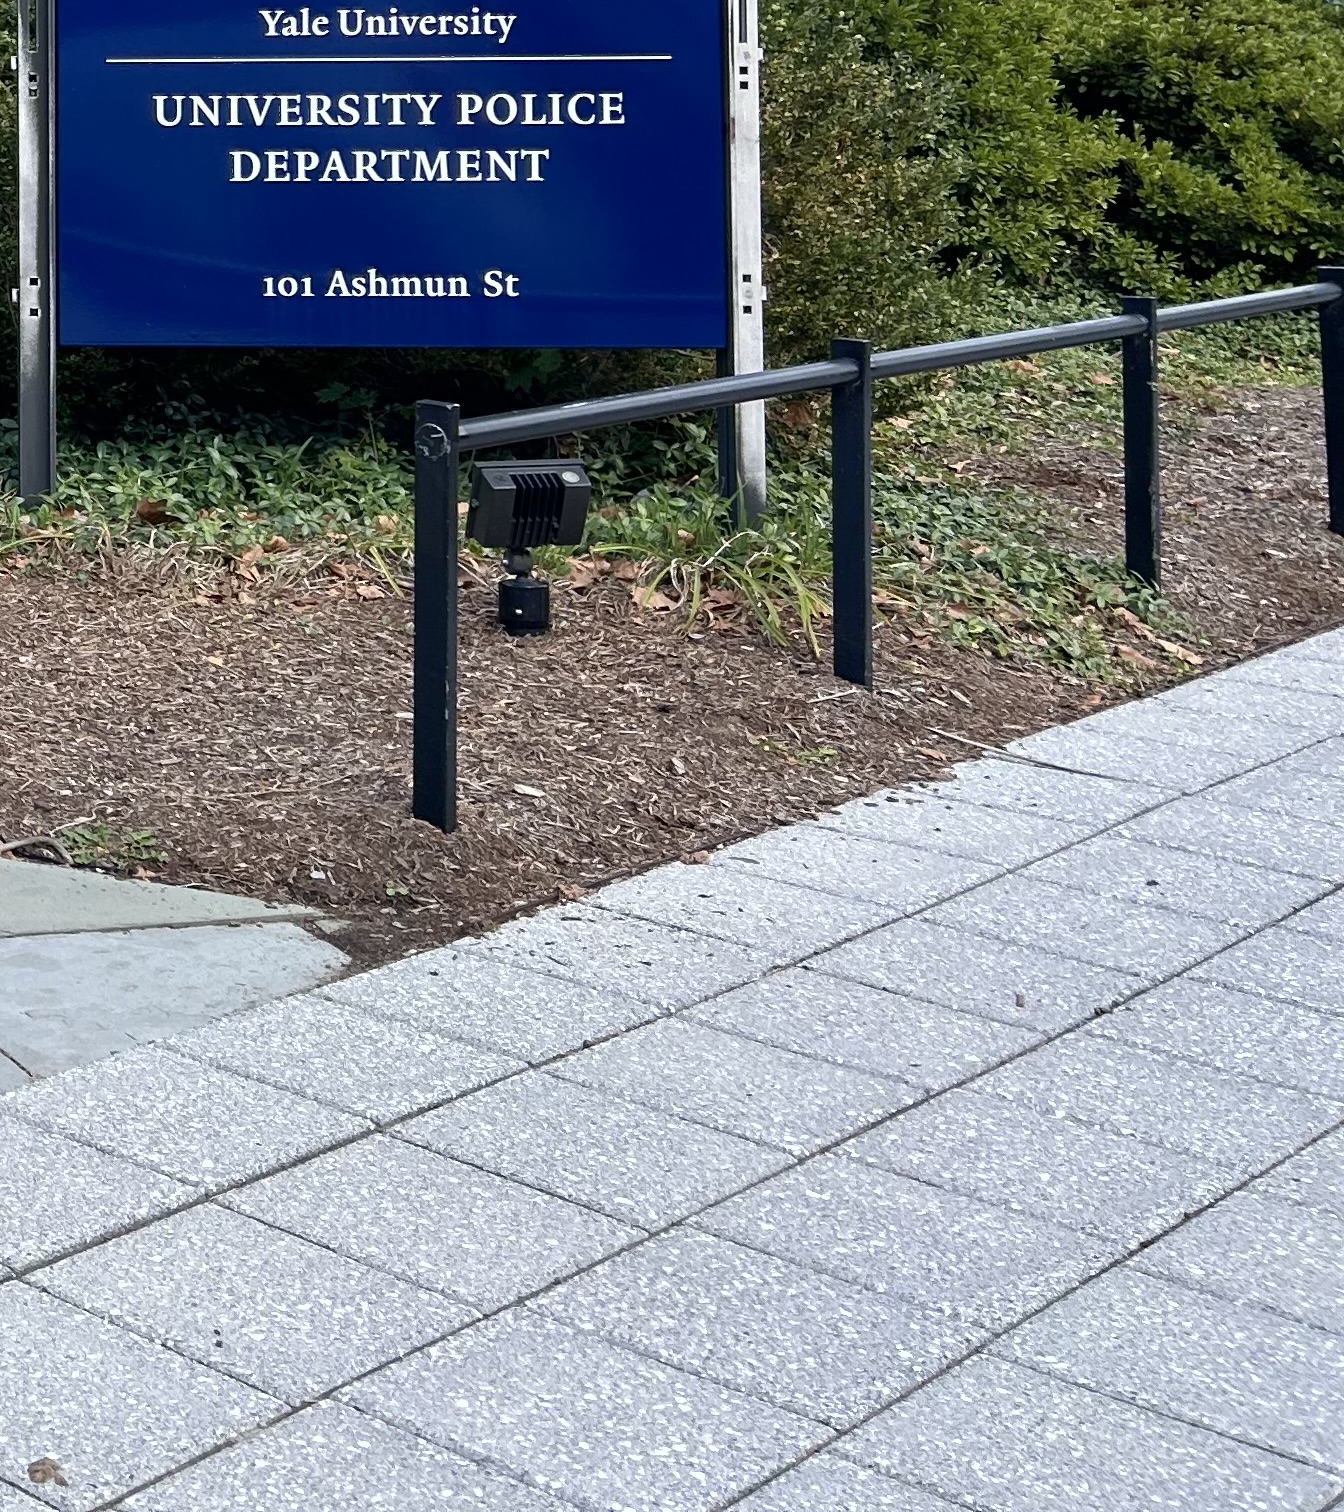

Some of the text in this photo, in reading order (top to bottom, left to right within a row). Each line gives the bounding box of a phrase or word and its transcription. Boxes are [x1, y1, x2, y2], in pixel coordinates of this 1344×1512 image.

[258, 7, 518, 44] Yale University
[152, 92, 626, 127] UNIVERSITY POLICE
[228, 149, 550, 183] DEPARTMENT
[262, 268, 520, 298] 101 Ashmun St
